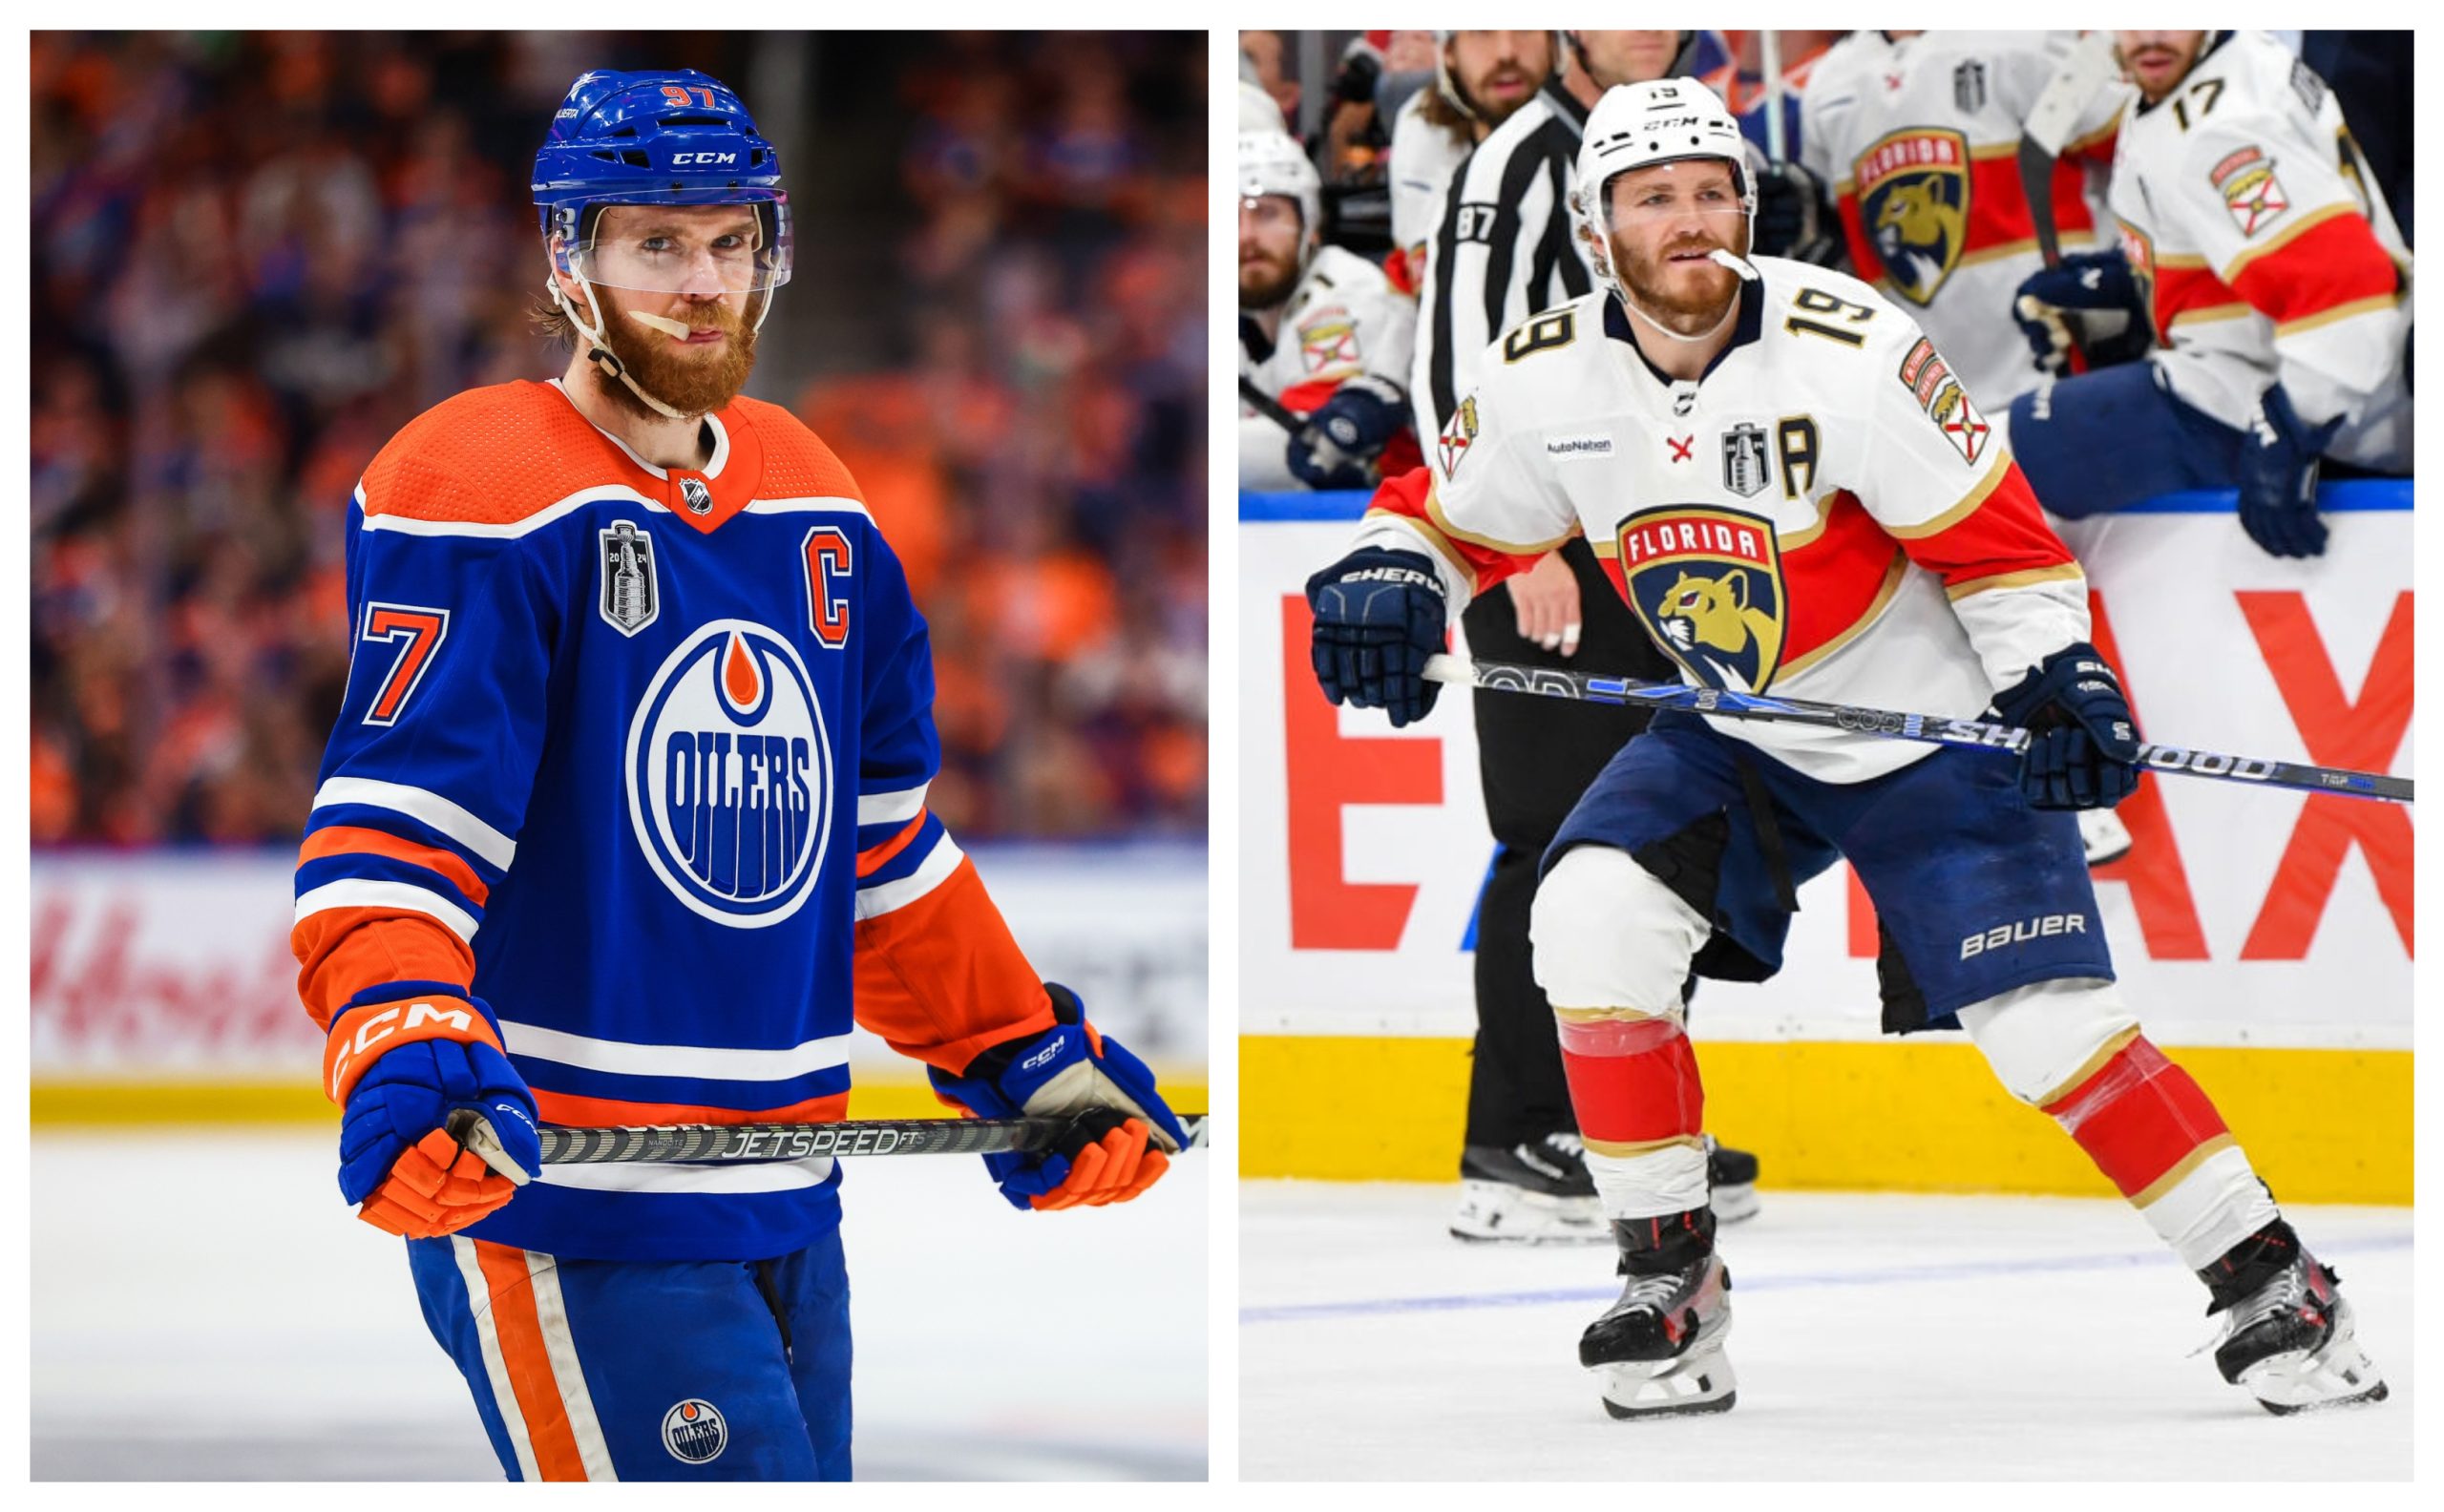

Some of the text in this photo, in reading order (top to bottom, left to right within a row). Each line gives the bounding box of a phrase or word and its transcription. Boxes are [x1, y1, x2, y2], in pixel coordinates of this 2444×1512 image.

[660, 86, 716, 108] 97
[2173, 77, 2225, 132] 17
[672, 152, 736, 165] CCM
[1456, 205, 1497, 241] 87
[1783, 286, 1878, 350] 19
[1777, 412, 1822, 500] A
[609, 553, 647, 563] 20 24
[1628, 522, 1759, 561] FLORIDA
[802, 526, 852, 649] C
[666, 730, 811, 899] OILERS
[332, 1003, 473, 1100] CCM
[1022, 1035, 1064, 1070] CCM
[722, 1129, 898, 1158] JETSPEED
[671, 1418, 721, 1460] OILERS
